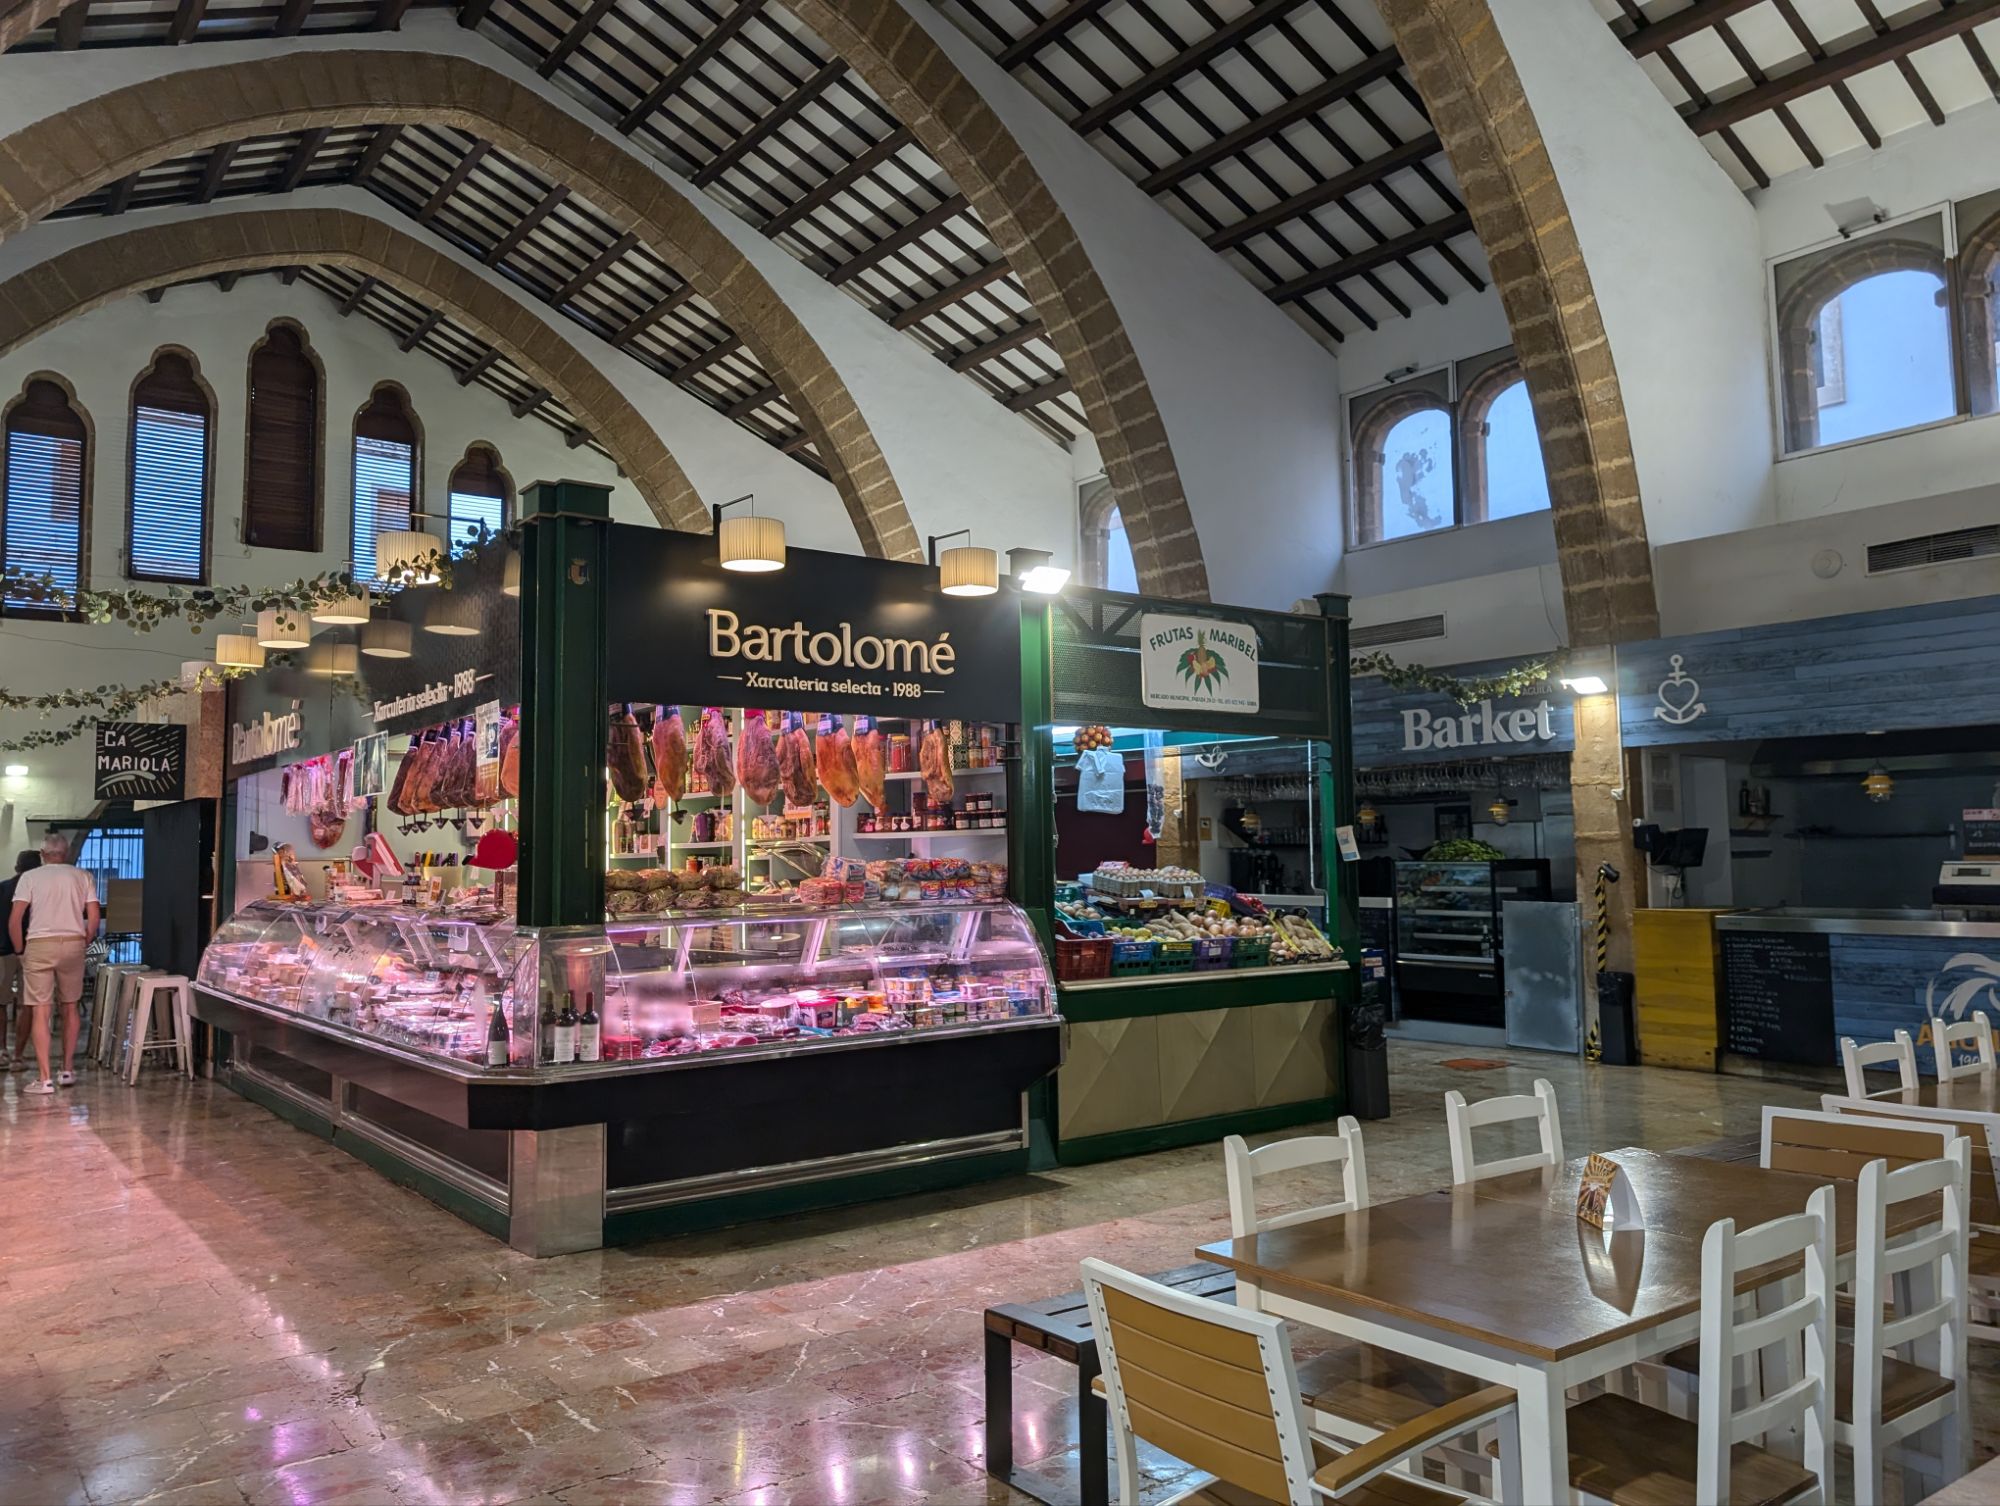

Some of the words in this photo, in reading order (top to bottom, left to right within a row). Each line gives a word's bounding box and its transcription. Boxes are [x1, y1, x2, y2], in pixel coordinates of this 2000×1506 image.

[706, 608, 955, 675] Bartolomé
[1149, 626, 1194, 651] FRUTAS
[1209, 628, 1256, 661] MARIBEL
[454, 668, 476, 698] 1988
[746, 672, 829, 692] Xarcuteria
[831, 679, 882, 696] selecta
[892, 682, 922, 698] 1988
[232, 699, 303, 765] Bartolomé
[1400, 699, 1556, 750] Barket
[98, 755, 171, 772] MARIOLA
